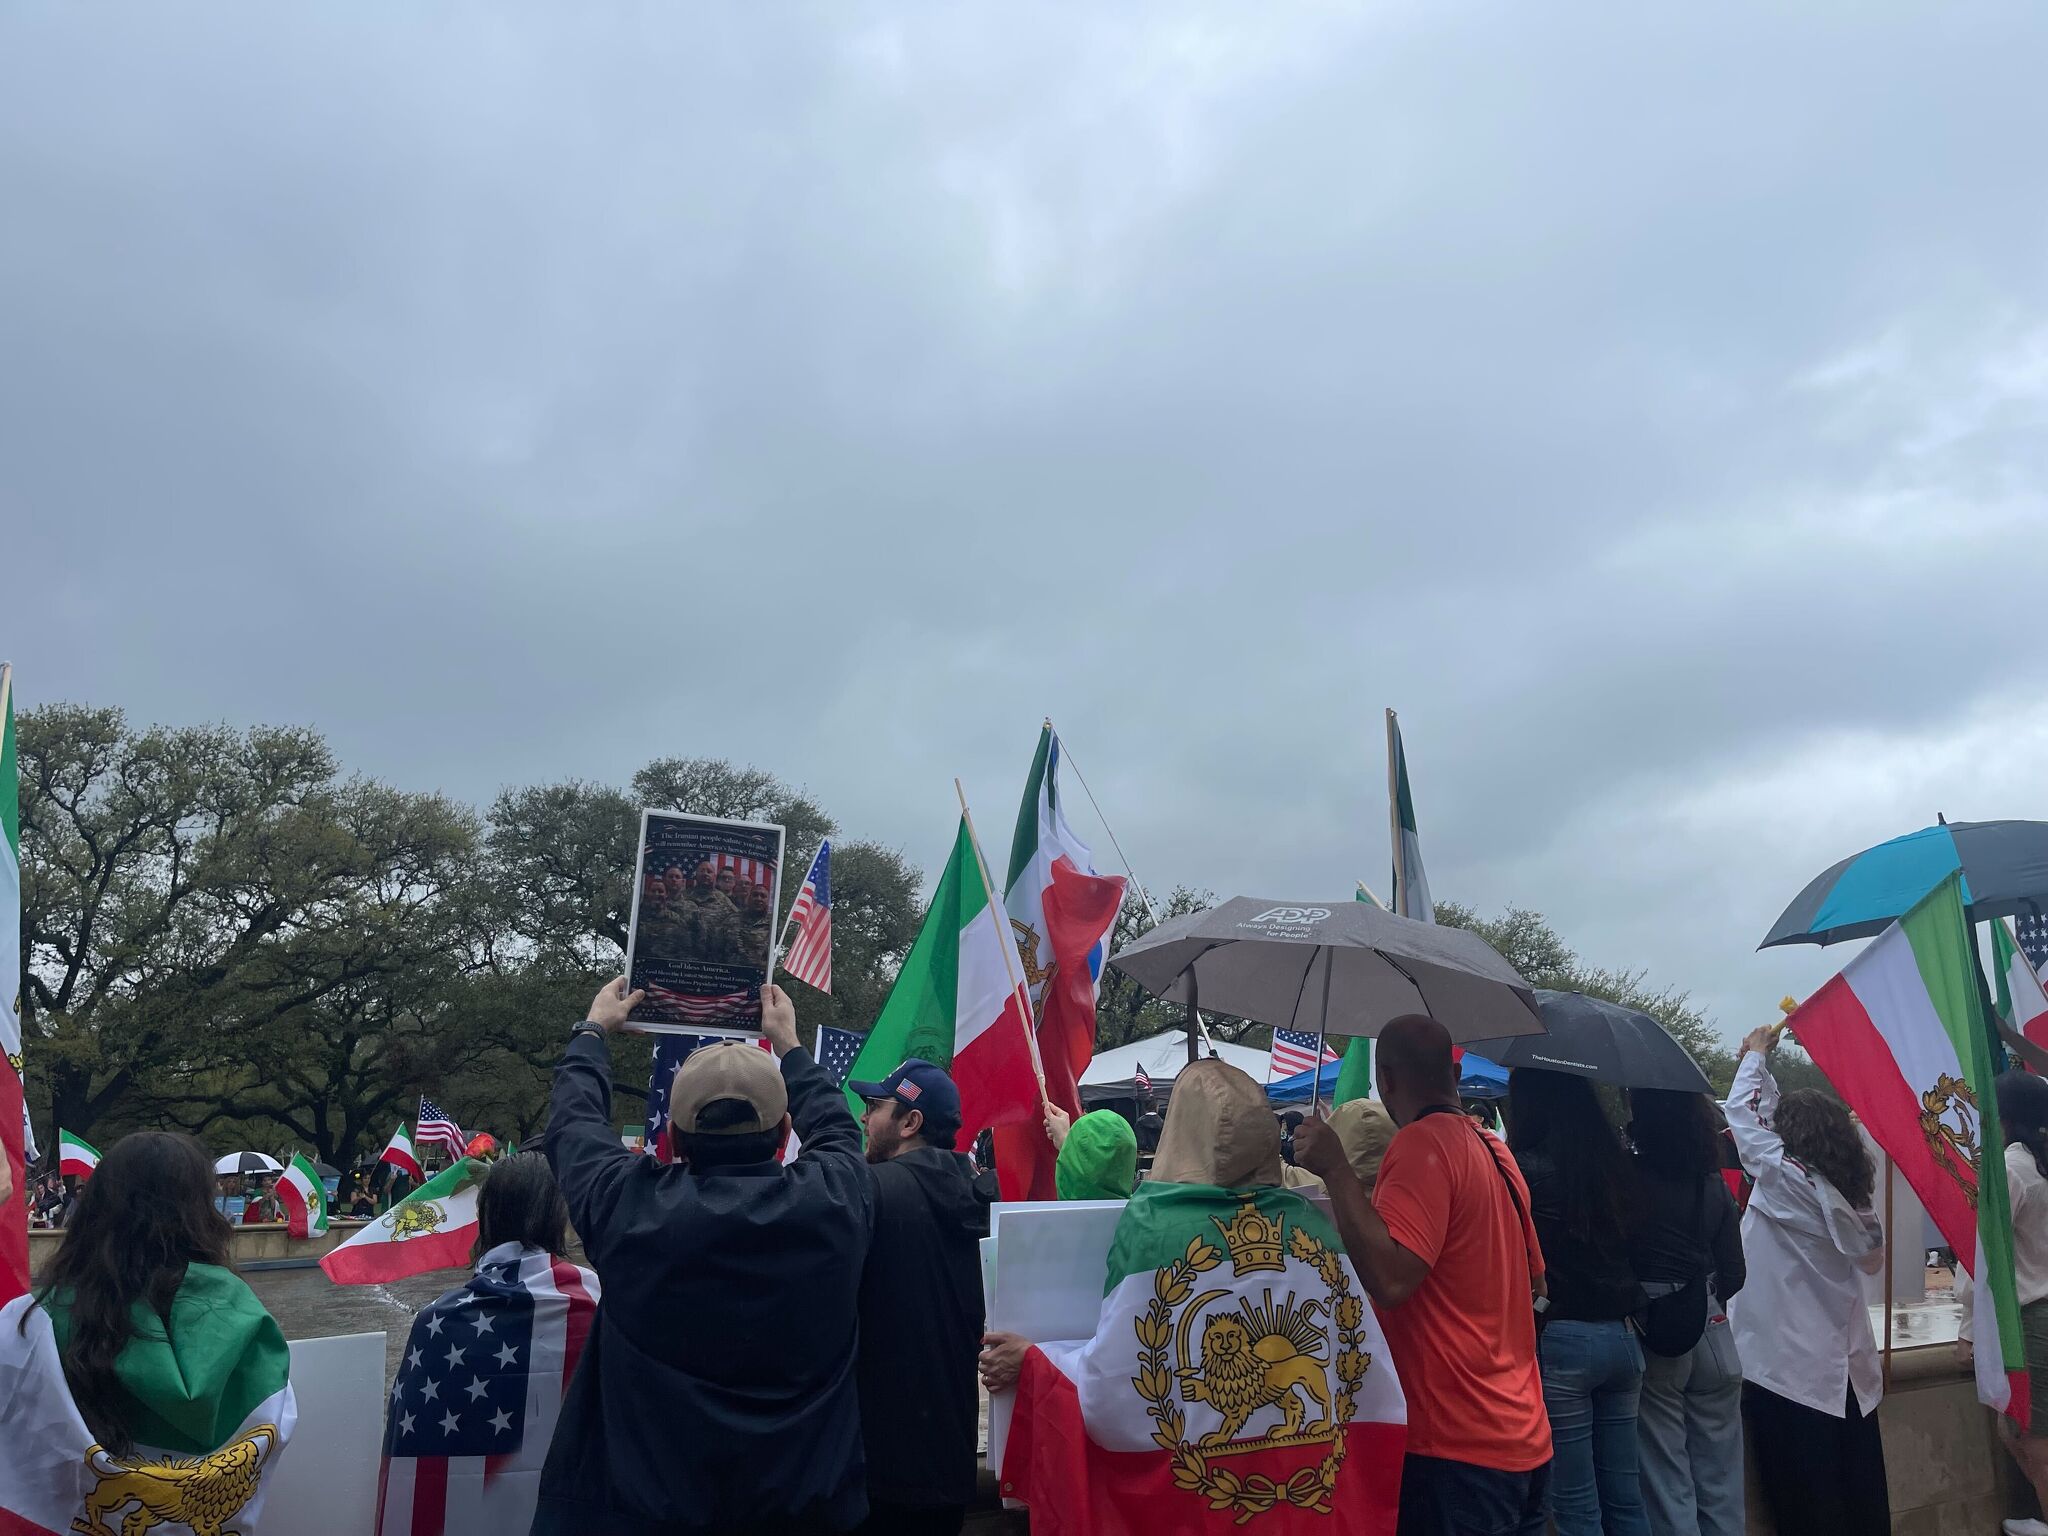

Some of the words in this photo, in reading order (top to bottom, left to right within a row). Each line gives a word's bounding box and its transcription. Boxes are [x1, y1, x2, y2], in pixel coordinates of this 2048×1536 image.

[661, 832, 673, 840] The
[675, 832, 699, 840] Iranian
[699, 834, 721, 842] people
[722, 837, 742, 846] salute
[666, 841, 697, 849] remember
[698, 842, 727, 851] America's
[728, 845, 747, 854] heroes
[1250, 907, 1331, 924] ADP
[1236, 922, 1267, 930] Always
[1269, 923, 1311, 932] Designing
[680, 971, 697, 979] United
[693, 980, 718, 988] President
[1531, 1053, 1598, 1070] TheHoustonDentists.com
